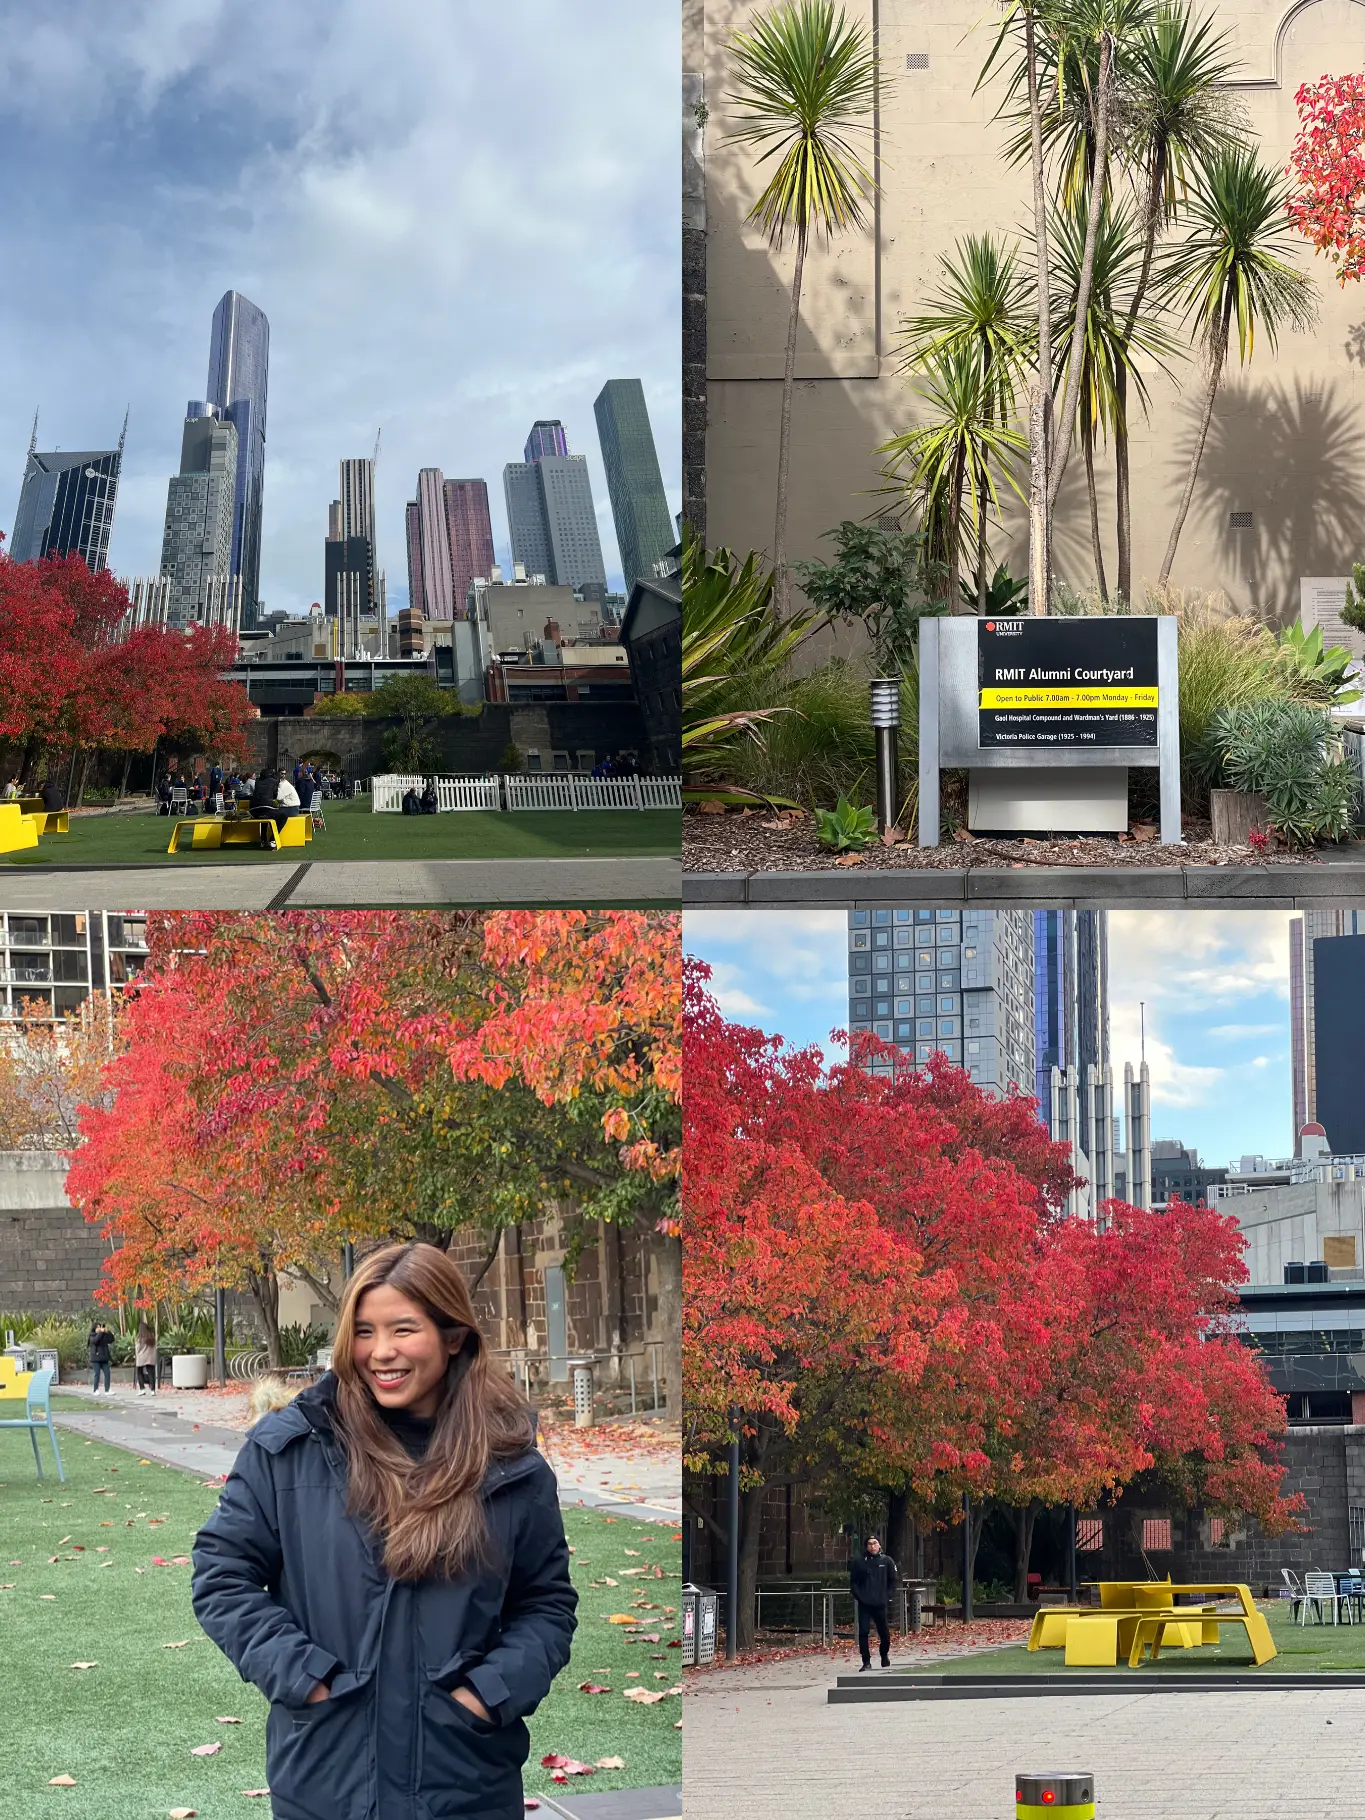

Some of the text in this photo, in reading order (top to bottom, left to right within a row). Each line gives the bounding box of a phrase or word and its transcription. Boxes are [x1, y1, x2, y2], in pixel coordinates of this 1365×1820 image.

[995, 621, 1024, 631] RMIT
[995, 666, 1134, 682] RMIT Alumni Courtyard
[996, 695, 1014, 703] Open
[1024, 694, 1044, 702] Public
[1045, 694, 1070, 702] 7.00am
[1076, 694, 1101, 703] 7.00pm
[1102, 694, 1128, 703] Monday
[1134, 694, 1155, 702] Friday
[994, 714, 1008, 722] Gaol
[1008, 714, 1031, 722] Hospital
[1032, 714, 1062, 722] Compound
[1139, 713, 1155, 721] 1925)
[1036, 733, 1058, 741] Garage
[1058, 733, 1075, 741] (1925
